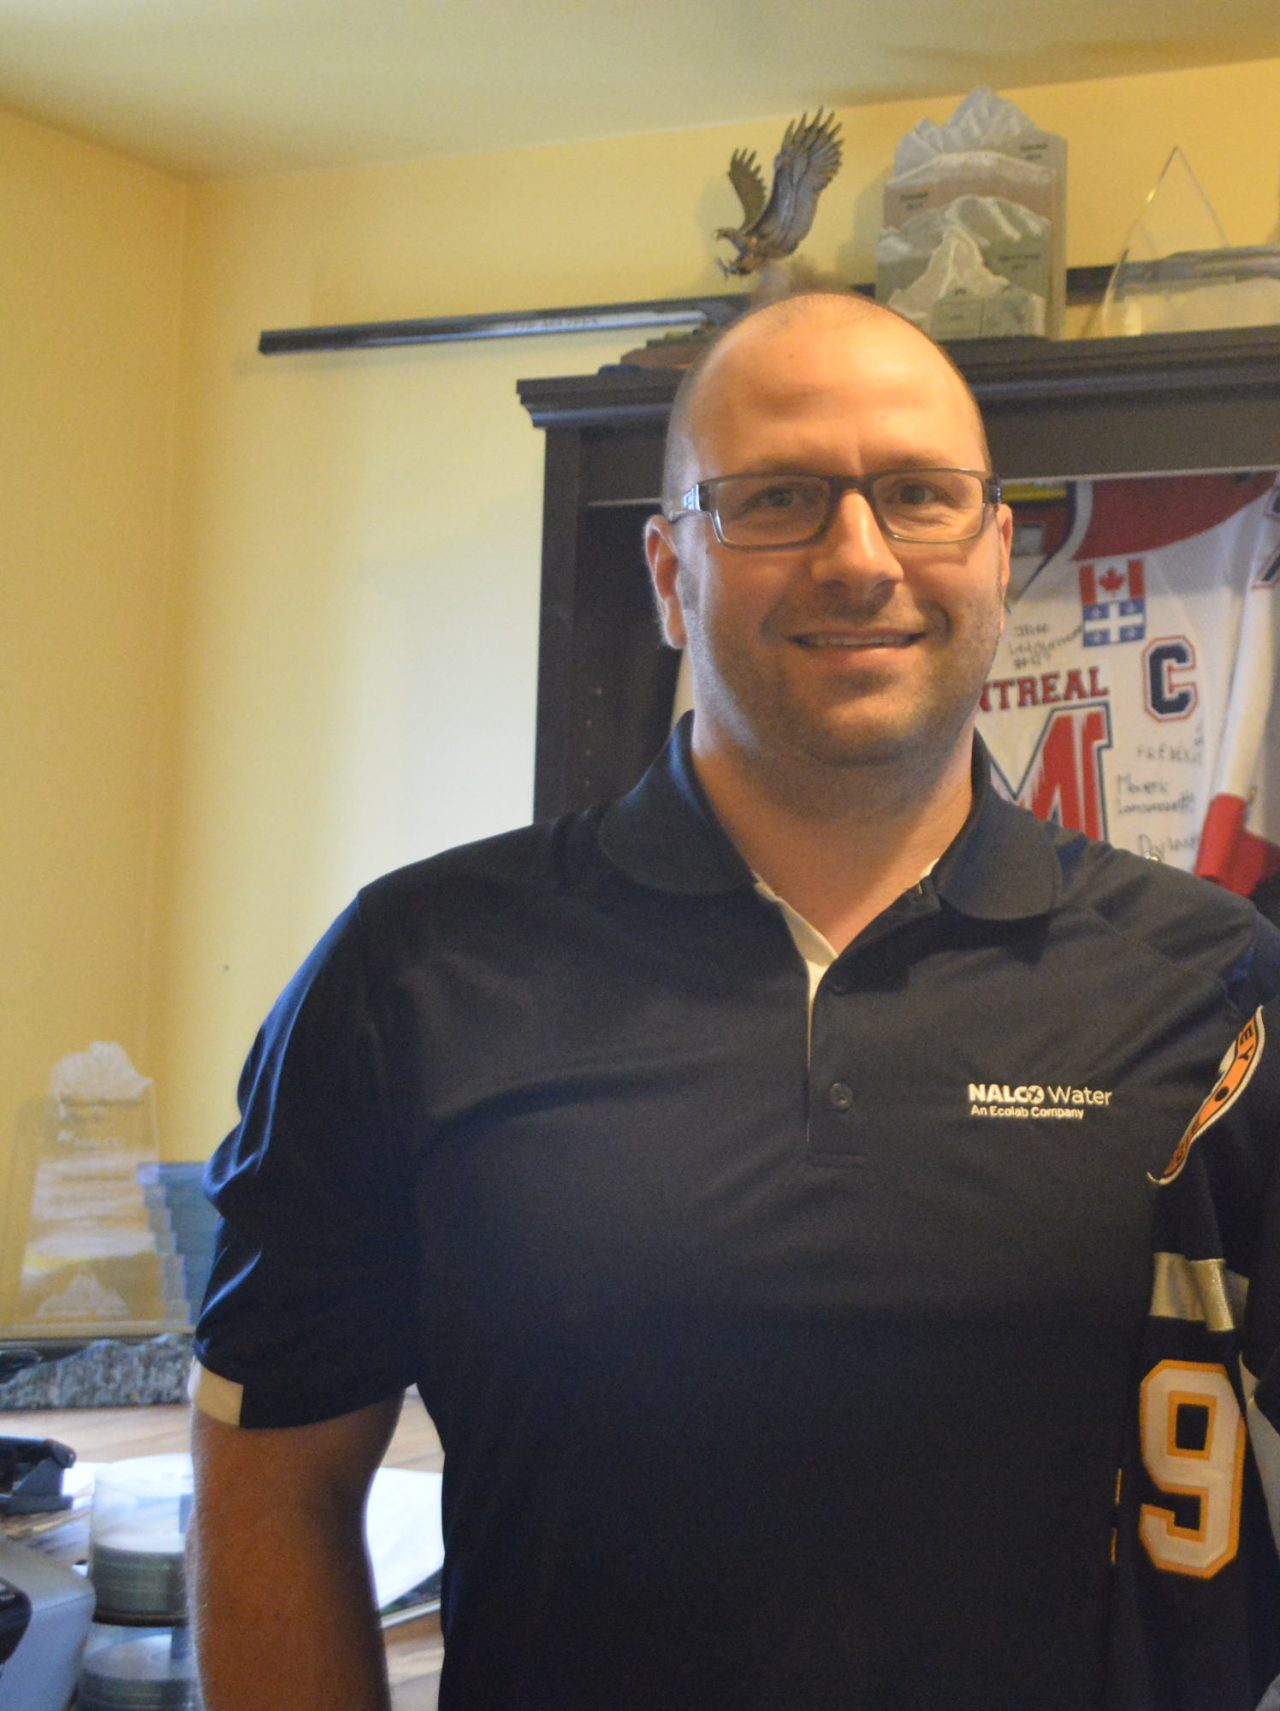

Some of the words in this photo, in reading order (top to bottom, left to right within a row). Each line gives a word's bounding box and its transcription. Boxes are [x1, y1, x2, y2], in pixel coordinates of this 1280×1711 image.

[1141, 635, 1199, 723] C
[971, 1105, 987, 1116] An
[989, 1105, 1029, 1118] Ecolab
[1030, 1106, 1084, 1120] Company
[1047, 1085, 1112, 1105] Water
[1138, 1359, 1247, 1580] 9
